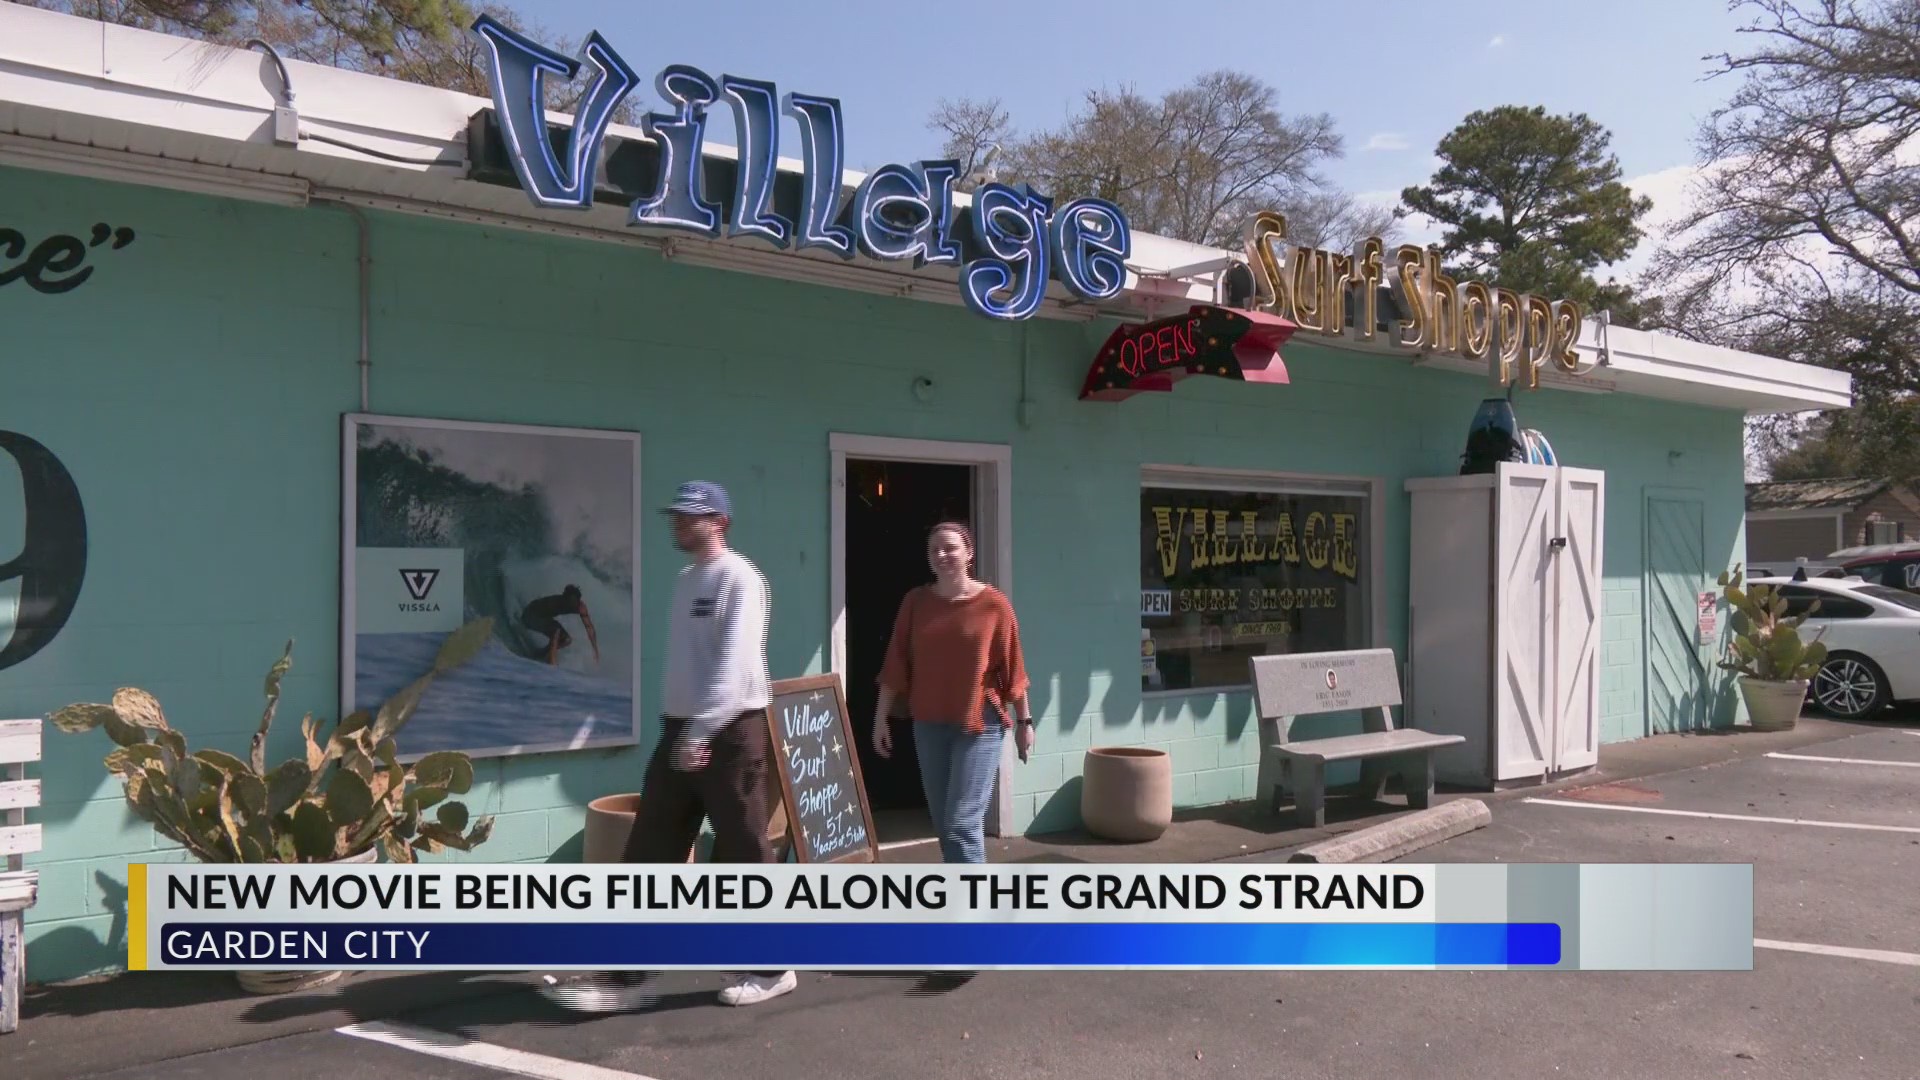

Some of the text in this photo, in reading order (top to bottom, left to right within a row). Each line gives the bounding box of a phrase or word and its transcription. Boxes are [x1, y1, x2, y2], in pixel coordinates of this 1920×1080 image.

[471, 13, 1131, 321] Village
[1246, 211, 1582, 390] Surf Shoppe
[1121, 320, 1196, 376] OPEN
[1152, 507, 1357, 578] VILLAGE
[398, 603, 441, 612] VISSLA
[1141, 593, 1170, 612] PEN
[1180, 587, 1337, 612] SURF SHOPPE
[784, 704, 834, 742] Village
[791, 745, 827, 784] Surf
